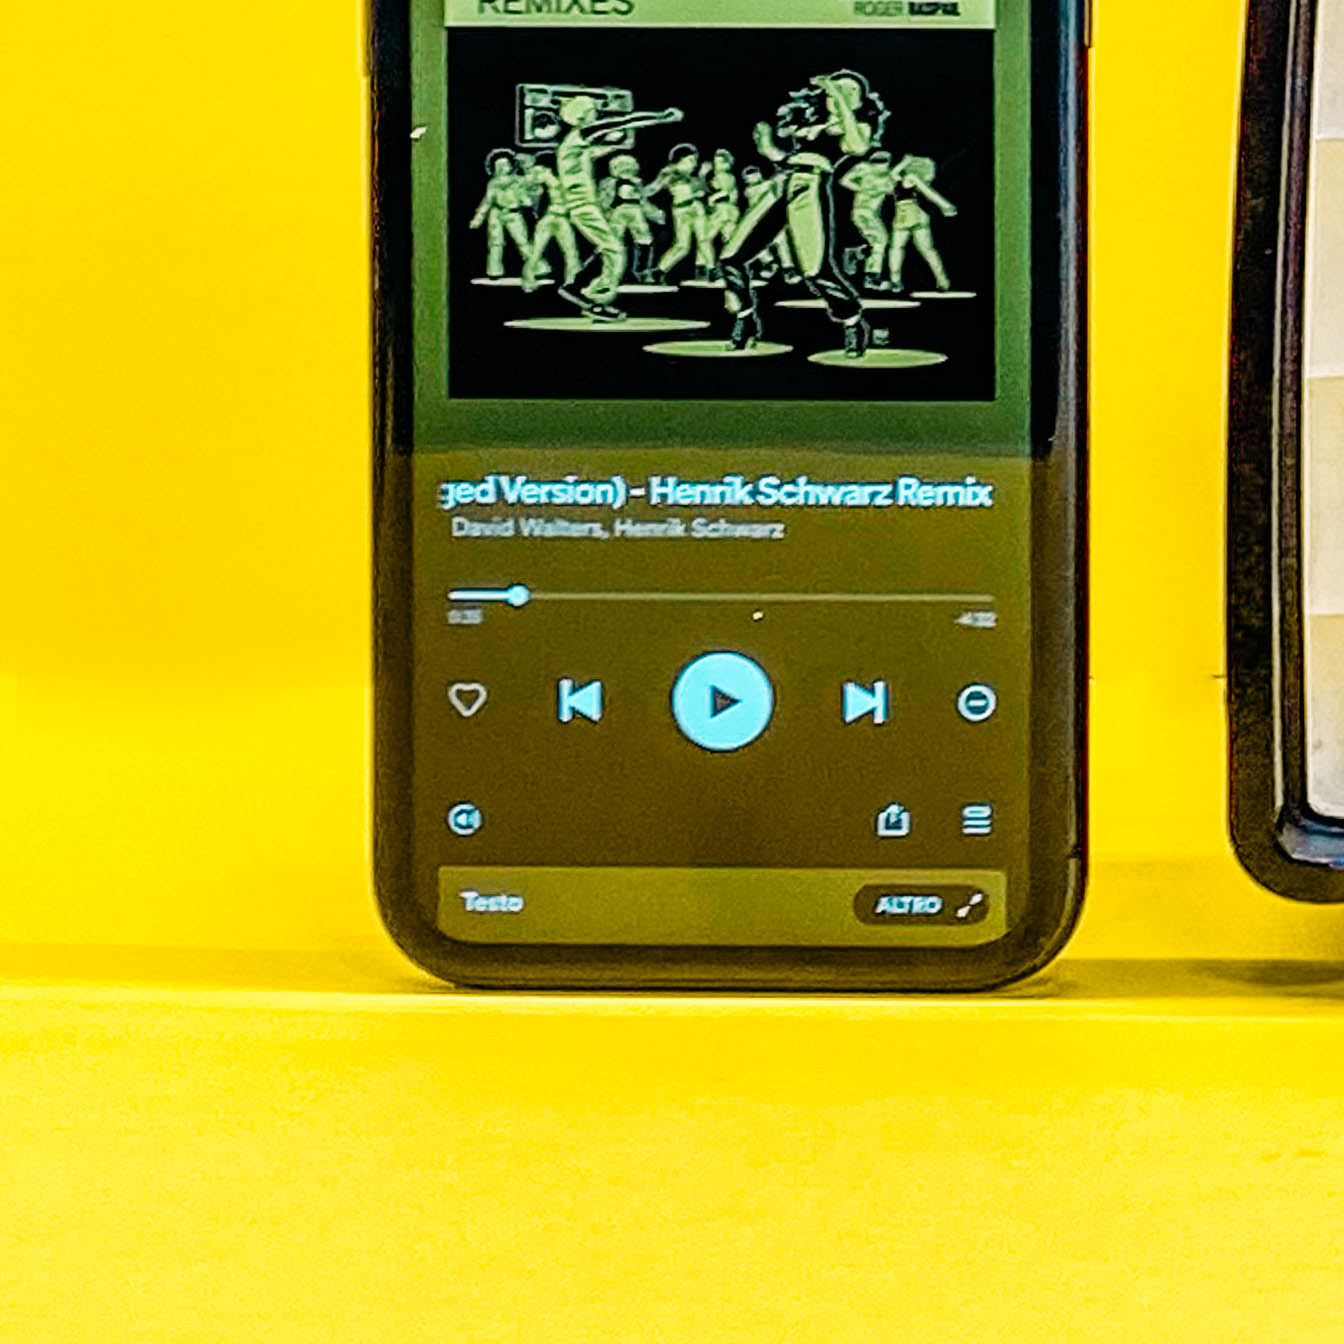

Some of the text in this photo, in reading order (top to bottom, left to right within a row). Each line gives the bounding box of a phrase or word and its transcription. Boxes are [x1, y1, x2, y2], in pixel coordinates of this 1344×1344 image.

[498, 475, 627, 508] Version)
[649, 475, 754, 505] Henrik
[756, 475, 894, 506] Schwarz
[896, 476, 993, 506] Remix
[451, 516, 516, 537] David
[614, 518, 686, 537] Henrik
[690, 518, 785, 539] Schwarz
[460, 891, 524, 912] Testo
